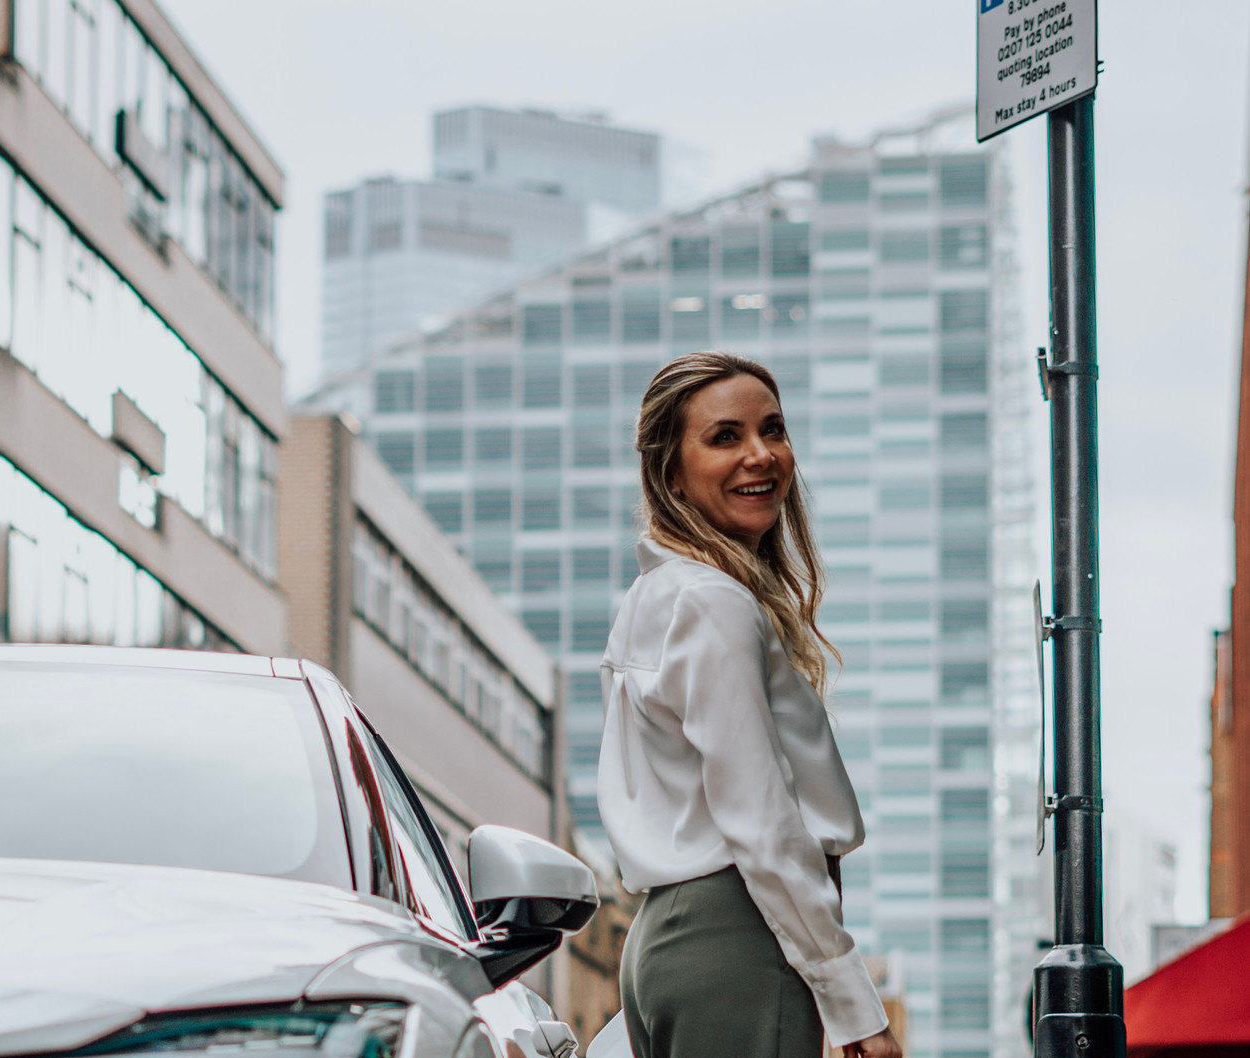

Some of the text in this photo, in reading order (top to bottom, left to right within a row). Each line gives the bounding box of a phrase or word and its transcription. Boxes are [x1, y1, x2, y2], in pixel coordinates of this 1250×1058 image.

[998, 13, 1073, 62] 0207 125 0044
[1004, 2, 1066, 41] Pay by phone
[997, 35, 1073, 82] quoting location
[1020, 61, 1050, 88] 79894
[995, 77, 1076, 124] Max stay 4 hours
